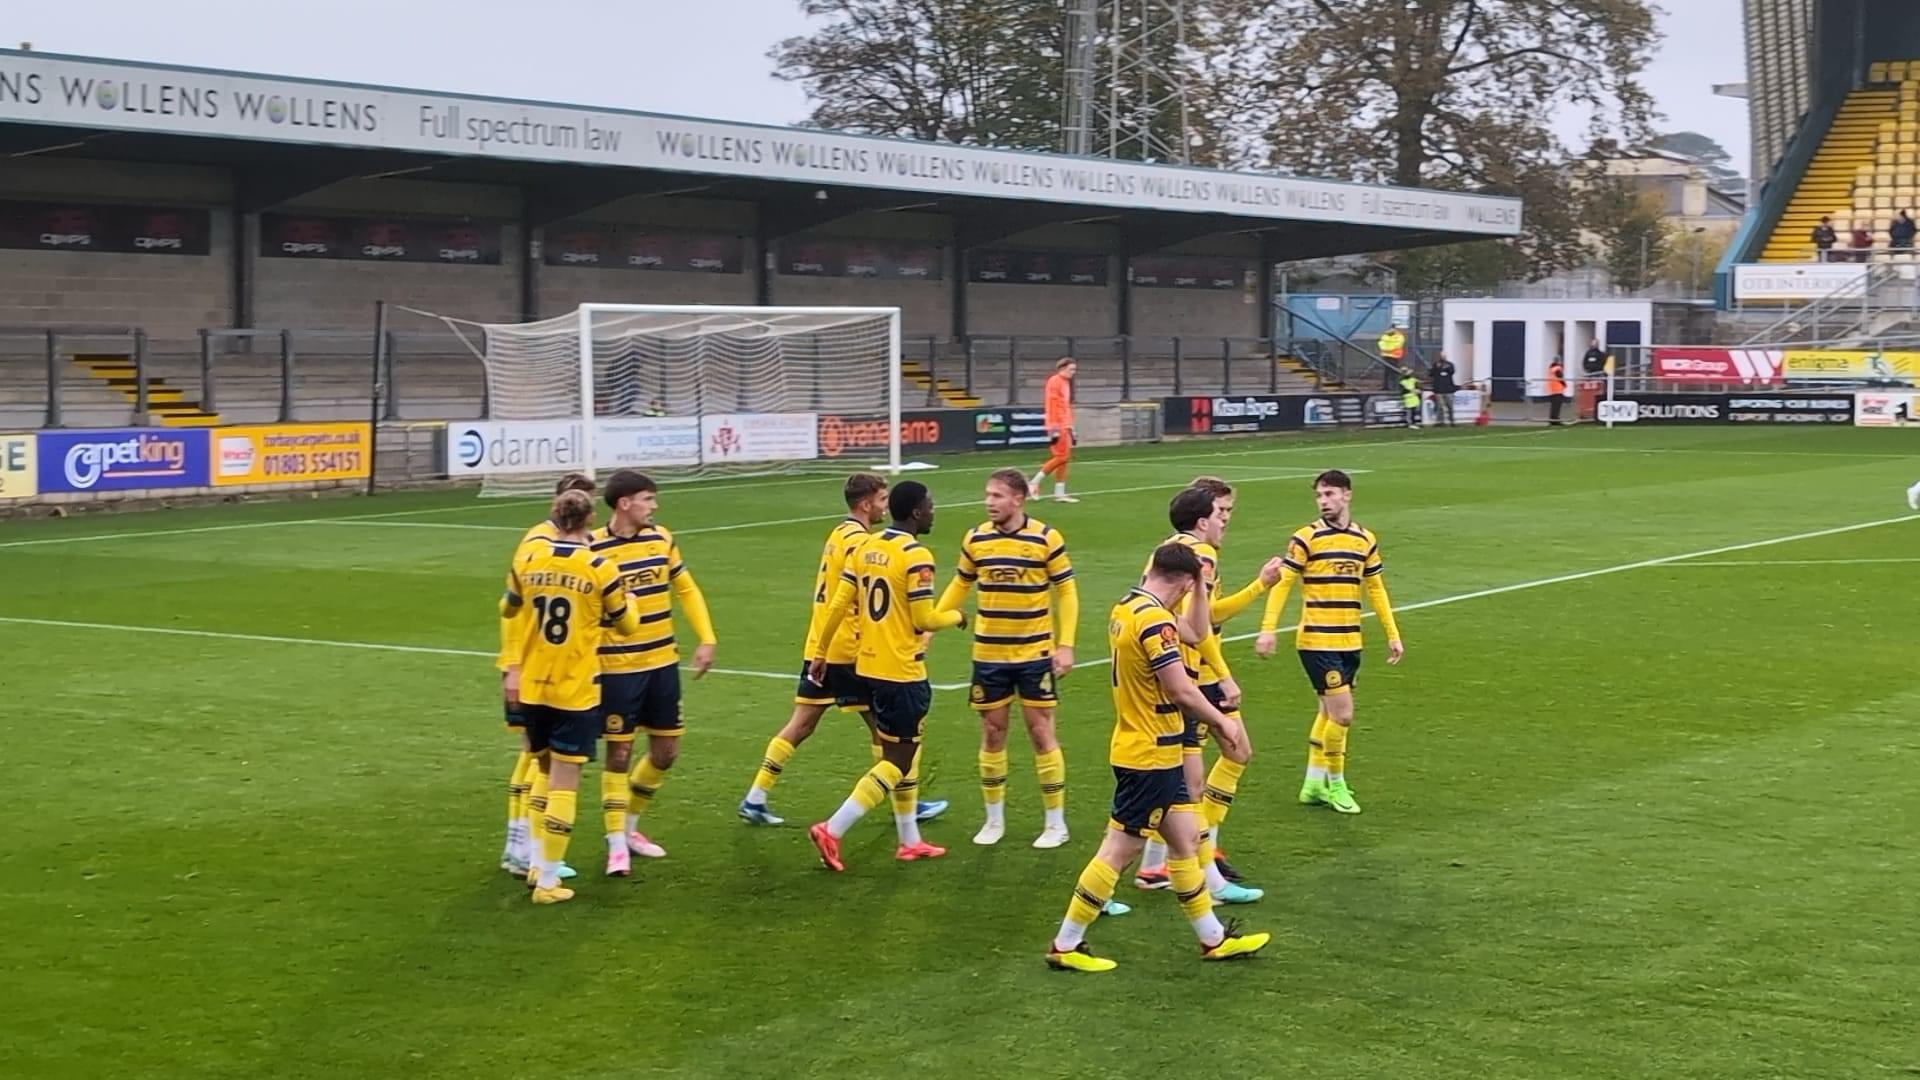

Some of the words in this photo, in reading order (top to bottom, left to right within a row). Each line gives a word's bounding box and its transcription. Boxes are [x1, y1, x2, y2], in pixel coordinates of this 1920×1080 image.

[0, 71, 42, 104] NS
[59, 76, 219, 118] WOLLENS
[233, 91, 378, 132] WOLLENS
[419, 105, 460, 140] Full
[466, 116, 578, 150] spectrum
[583, 118, 622, 152] law
[656, 130, 762, 164] WOLLENS
[771, 140, 868, 173] WOLLENS
[876, 151, 965, 181] WOLLENS
[972, 159, 1053, 188] WOLLENS
[1060, 168, 1135, 195] WOLLENS
[1141, 175, 1210, 201] WOLLENS
[1214, 181, 1280, 207] WOLLENS
[1284, 188, 1345, 212] WOLLENS
[846, 420, 940, 446] vanaama
[1639, 405, 1719, 418] SOLUTIONS
[0, 441, 26, 471] E
[263, 454, 306, 475] 01803
[310, 452, 361, 472] 554151
[489, 424, 597, 467] darnell
[532, 595, 571, 645] 18
[862, 575, 891, 622] 10
